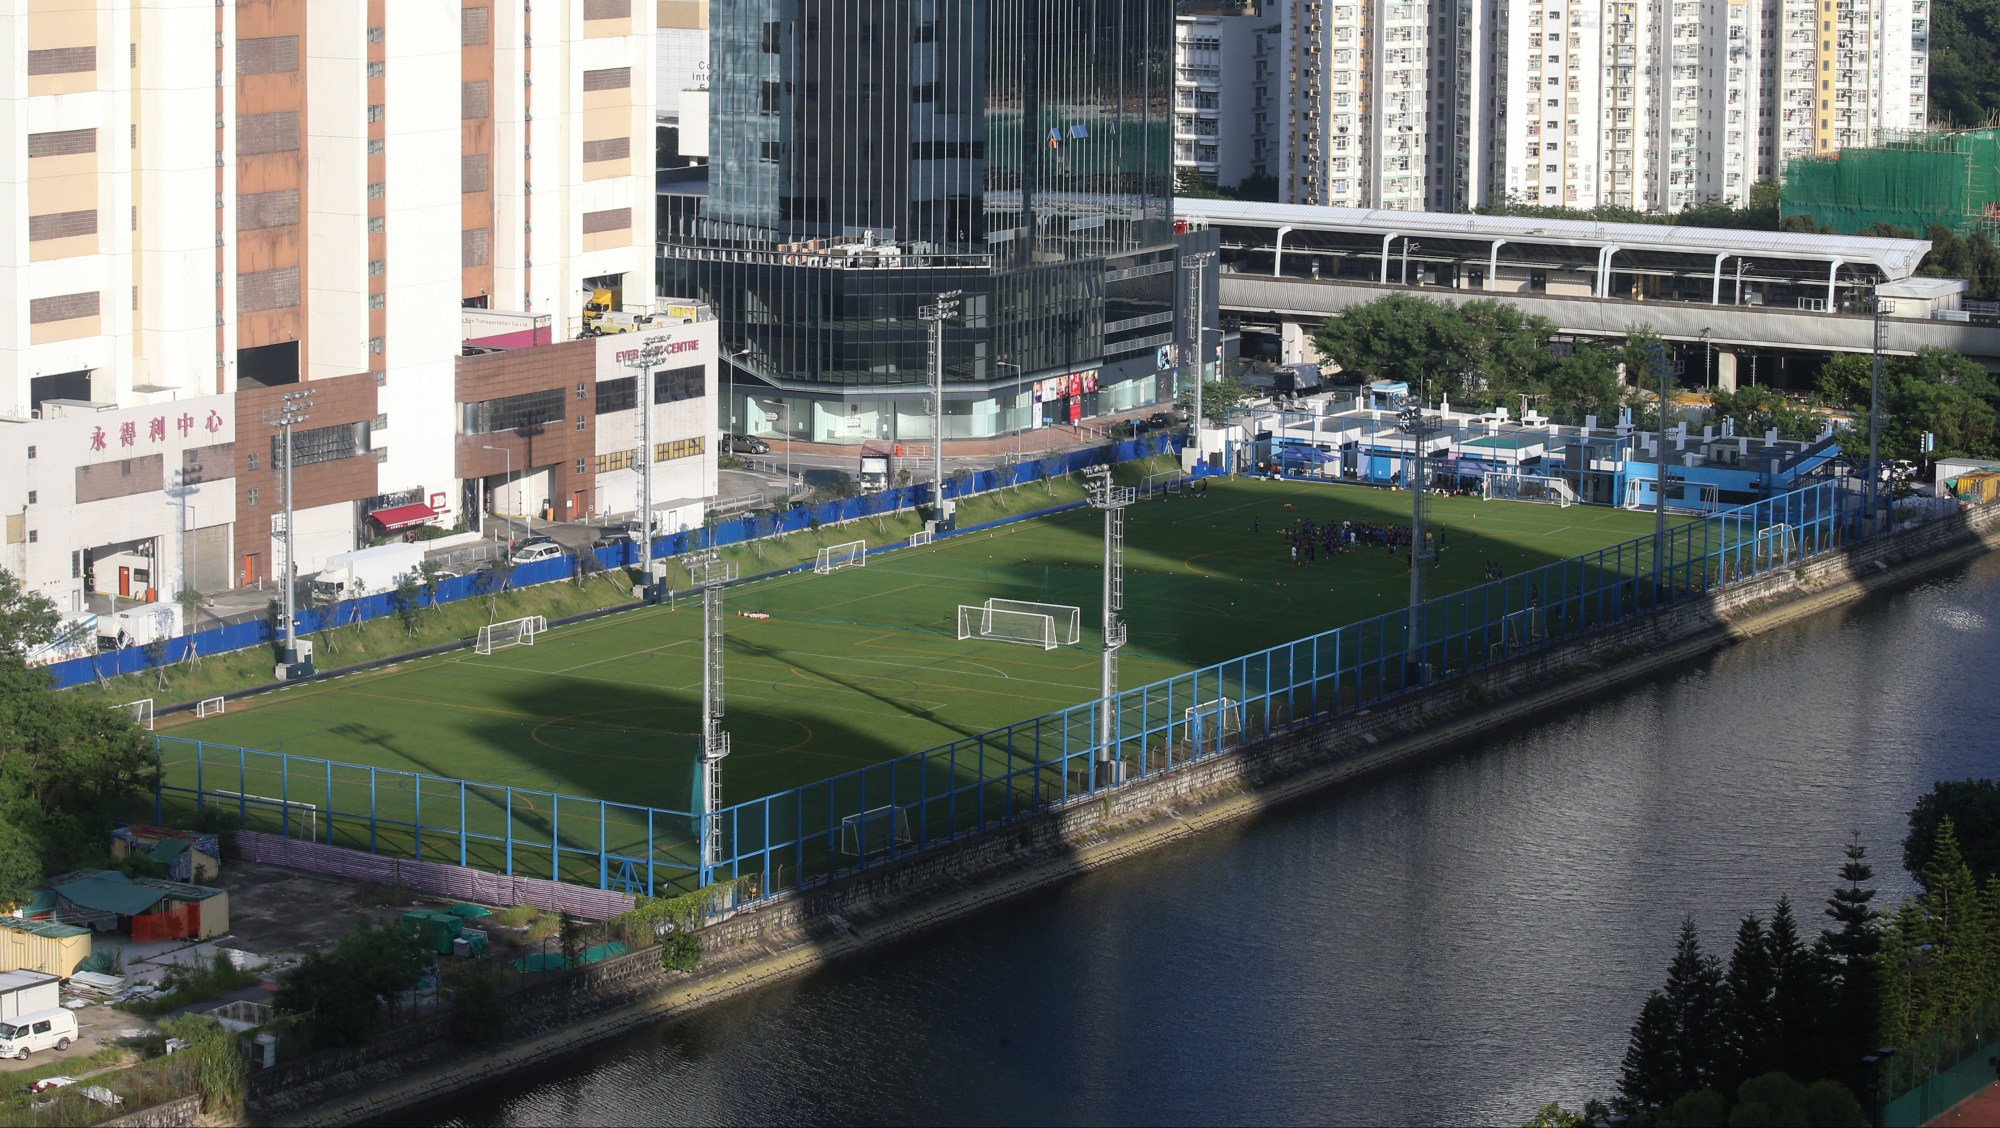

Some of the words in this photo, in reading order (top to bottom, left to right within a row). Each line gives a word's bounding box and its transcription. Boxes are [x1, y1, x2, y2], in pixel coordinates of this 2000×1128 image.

[615, 349, 639, 363] EVER
[666, 339, 700, 355] CENTRE
[90, 409, 223, 452] 永得利中心
